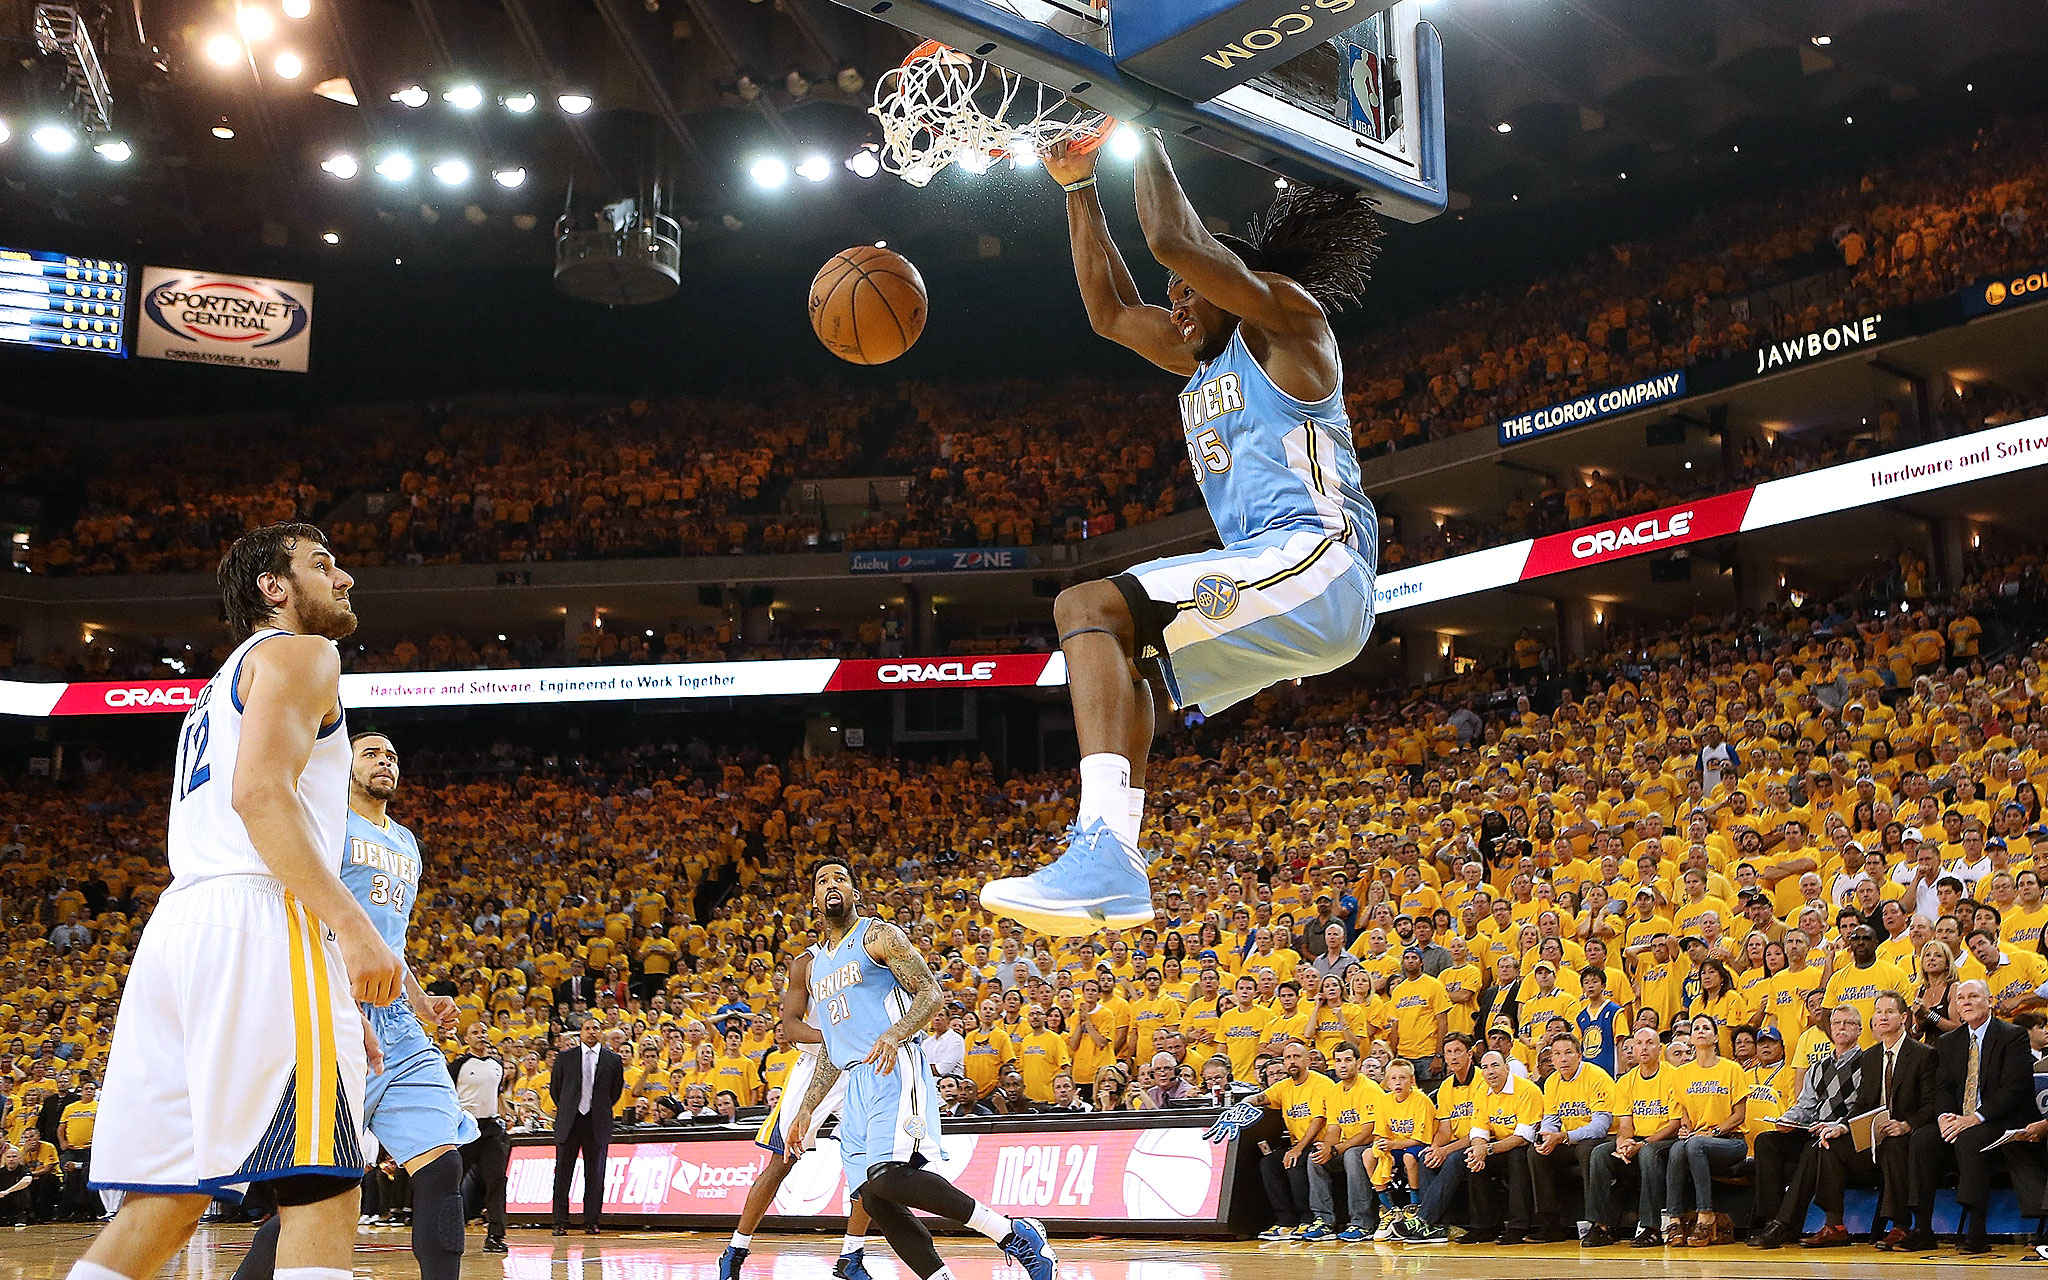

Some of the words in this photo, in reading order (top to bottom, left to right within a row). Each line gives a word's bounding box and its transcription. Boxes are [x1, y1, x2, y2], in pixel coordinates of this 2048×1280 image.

[156, 290, 295, 318] SPORTSNET
[182, 310, 271, 331] CENTRAL
[1757, 315, 1879, 373] JAWBONE
[1502, 415, 1533, 439] THE
[1534, 397, 1597, 431] CLOROX
[1598, 373, 1680, 413] COMPANY
[1187, 427, 1232, 485] 35
[1871, 459, 1953, 487] Hardware
[1959, 446, 1990, 467] and
[1571, 511, 1692, 559] ORACLE
[851, 555, 889, 571] Lucky
[370, 684, 436, 697] Hardware
[441, 682, 464, 694] and
[540, 677, 615, 694] Engineered
[621, 678, 633, 689] to
[637, 676, 672, 688] Work
[677, 674, 736, 690] Together
[877, 662, 995, 683] ORACLE
[105, 686, 203, 708] ORACL
[180, 710, 211, 802] 12
[351, 837, 419, 885] DENVER
[369, 874, 407, 914] 34
[812, 960, 863, 1004] DENVER
[827, 993, 851, 1026] 21
[1813, 1041, 1831, 1052] WE
[699, 1162, 757, 1187] boost
[1058, 1144, 1098, 1207] 24
[696, 1187, 729, 1199] mobile
